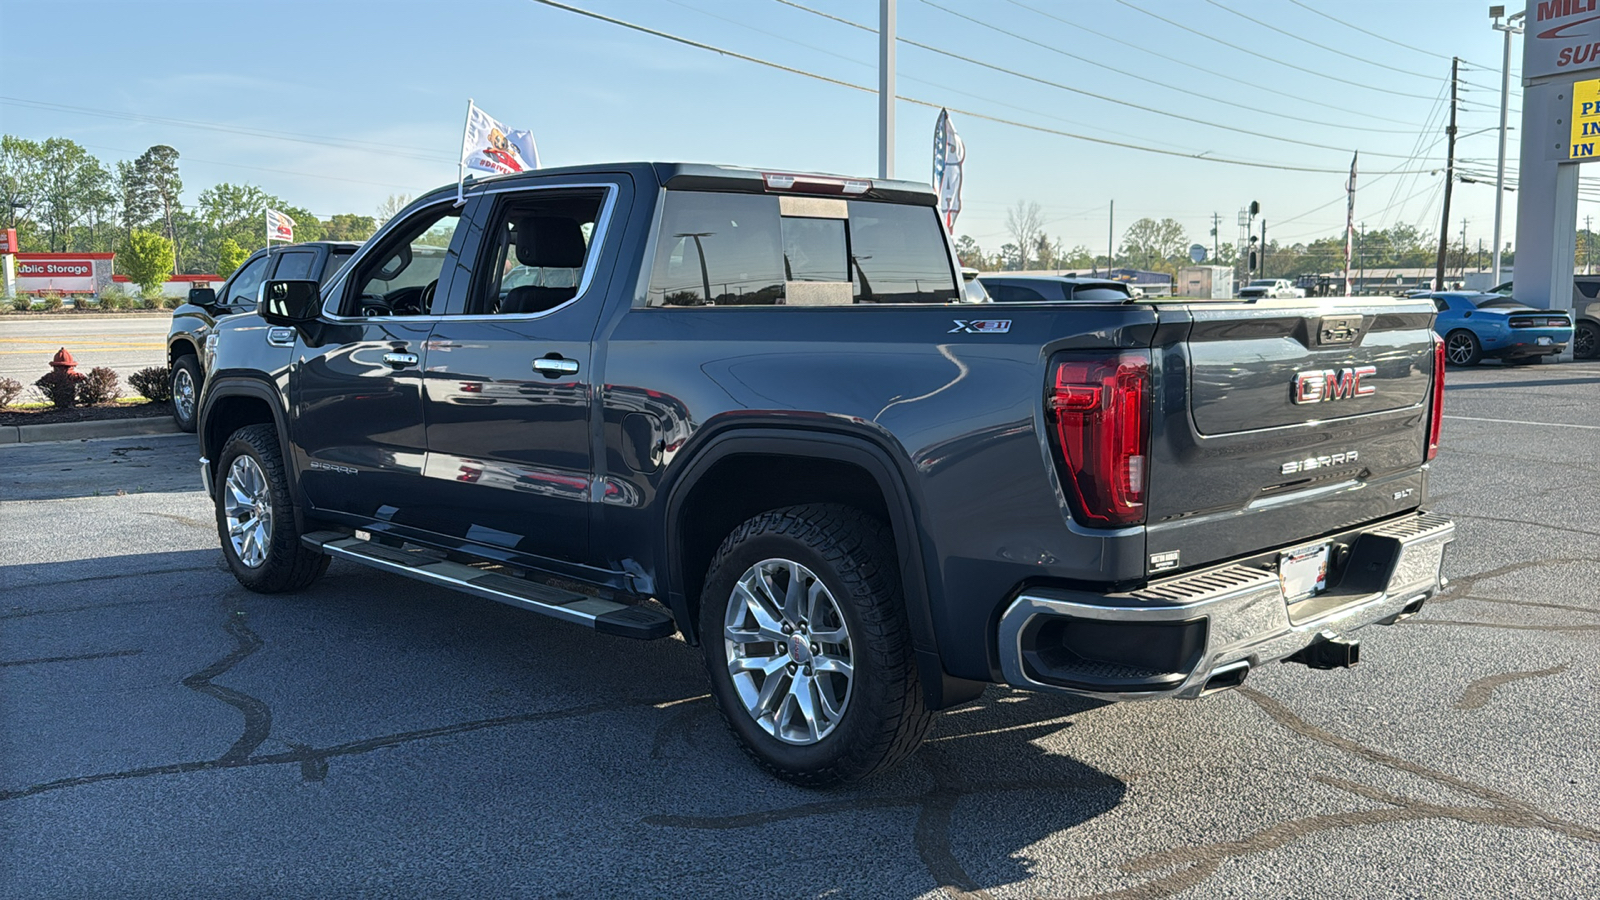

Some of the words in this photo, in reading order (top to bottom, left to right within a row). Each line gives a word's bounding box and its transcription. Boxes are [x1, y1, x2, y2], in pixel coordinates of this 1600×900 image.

[1572, 143, 1595, 157] IN
[18, 264, 44, 274] ublic
[47, 264, 88, 275] Storage
[1292, 366, 1377, 405] GMC
[310, 461, 359, 475] SIERRA
[1281, 450, 1359, 475] SIERRA
[1392, 488, 1414, 500] SLT
